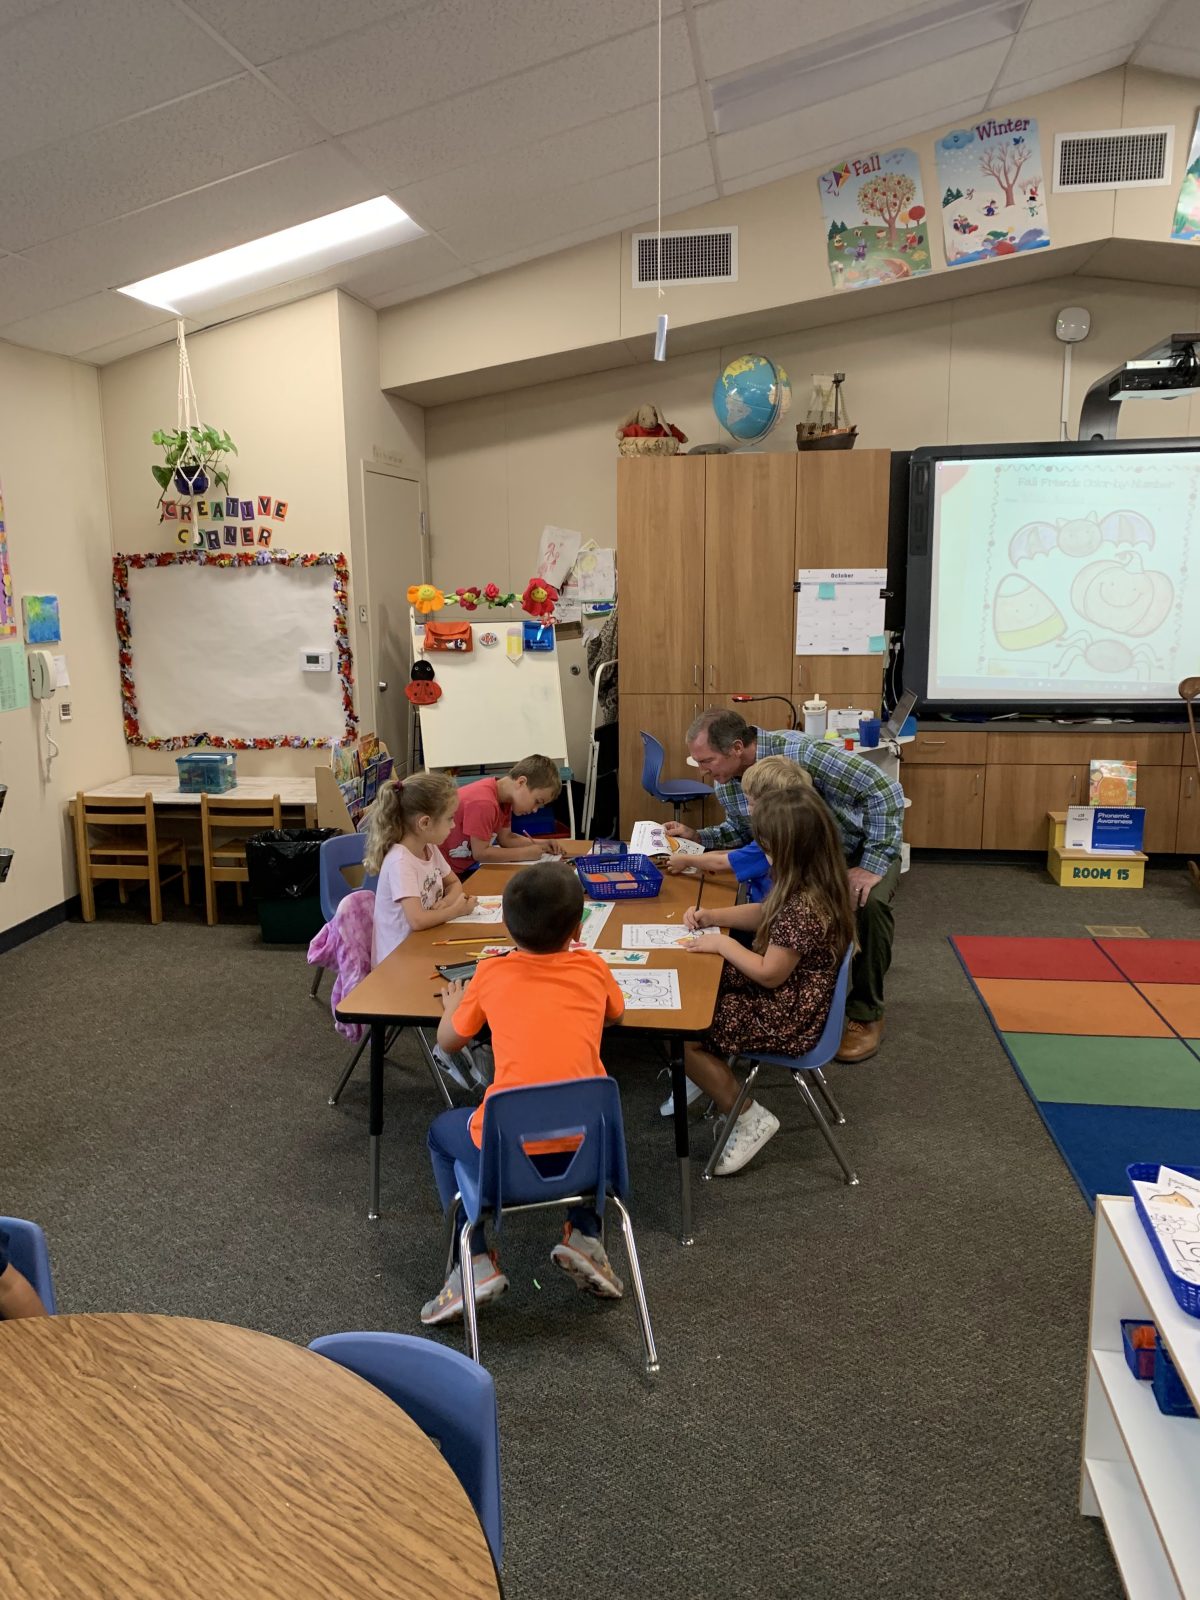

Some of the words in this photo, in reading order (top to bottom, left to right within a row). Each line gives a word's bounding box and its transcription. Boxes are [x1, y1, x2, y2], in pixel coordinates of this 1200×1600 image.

[976, 118, 1030, 141] Winter
[851, 154, 882, 177] Fall
[164, 496, 287, 521] CREATIVE
[1072, 866, 1112, 880] ROOM
[1116, 868, 1130, 881] 15
